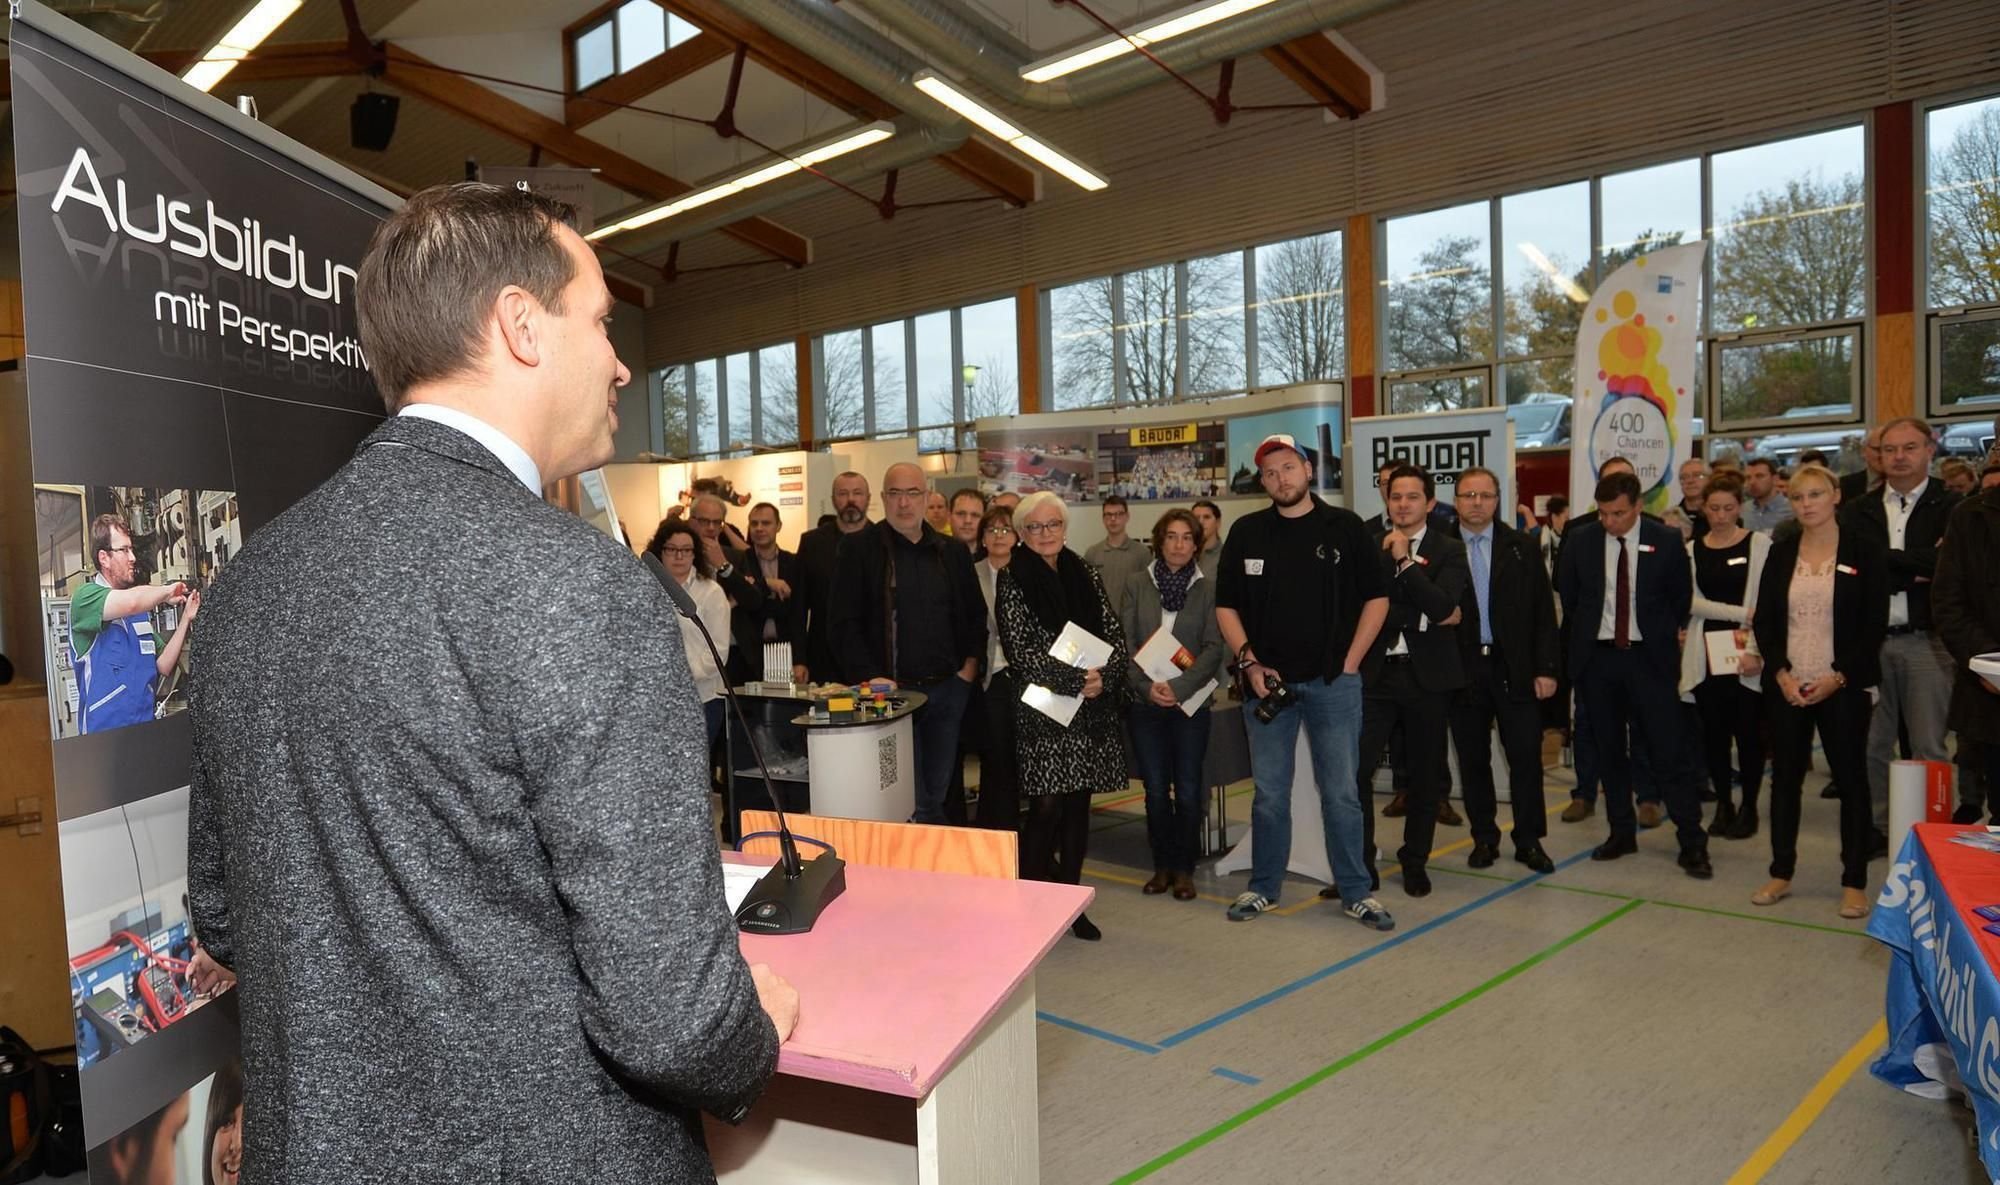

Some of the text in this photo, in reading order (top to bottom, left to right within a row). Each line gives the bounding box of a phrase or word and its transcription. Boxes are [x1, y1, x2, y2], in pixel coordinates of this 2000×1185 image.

[51, 146, 359, 304] Ausbildun
[154, 290, 370, 372] mit Perspektiv
[1139, 425, 1189, 443] BAUDAT
[1609, 412, 1645, 434] 400
[1617, 435, 1664, 449] Chancen
